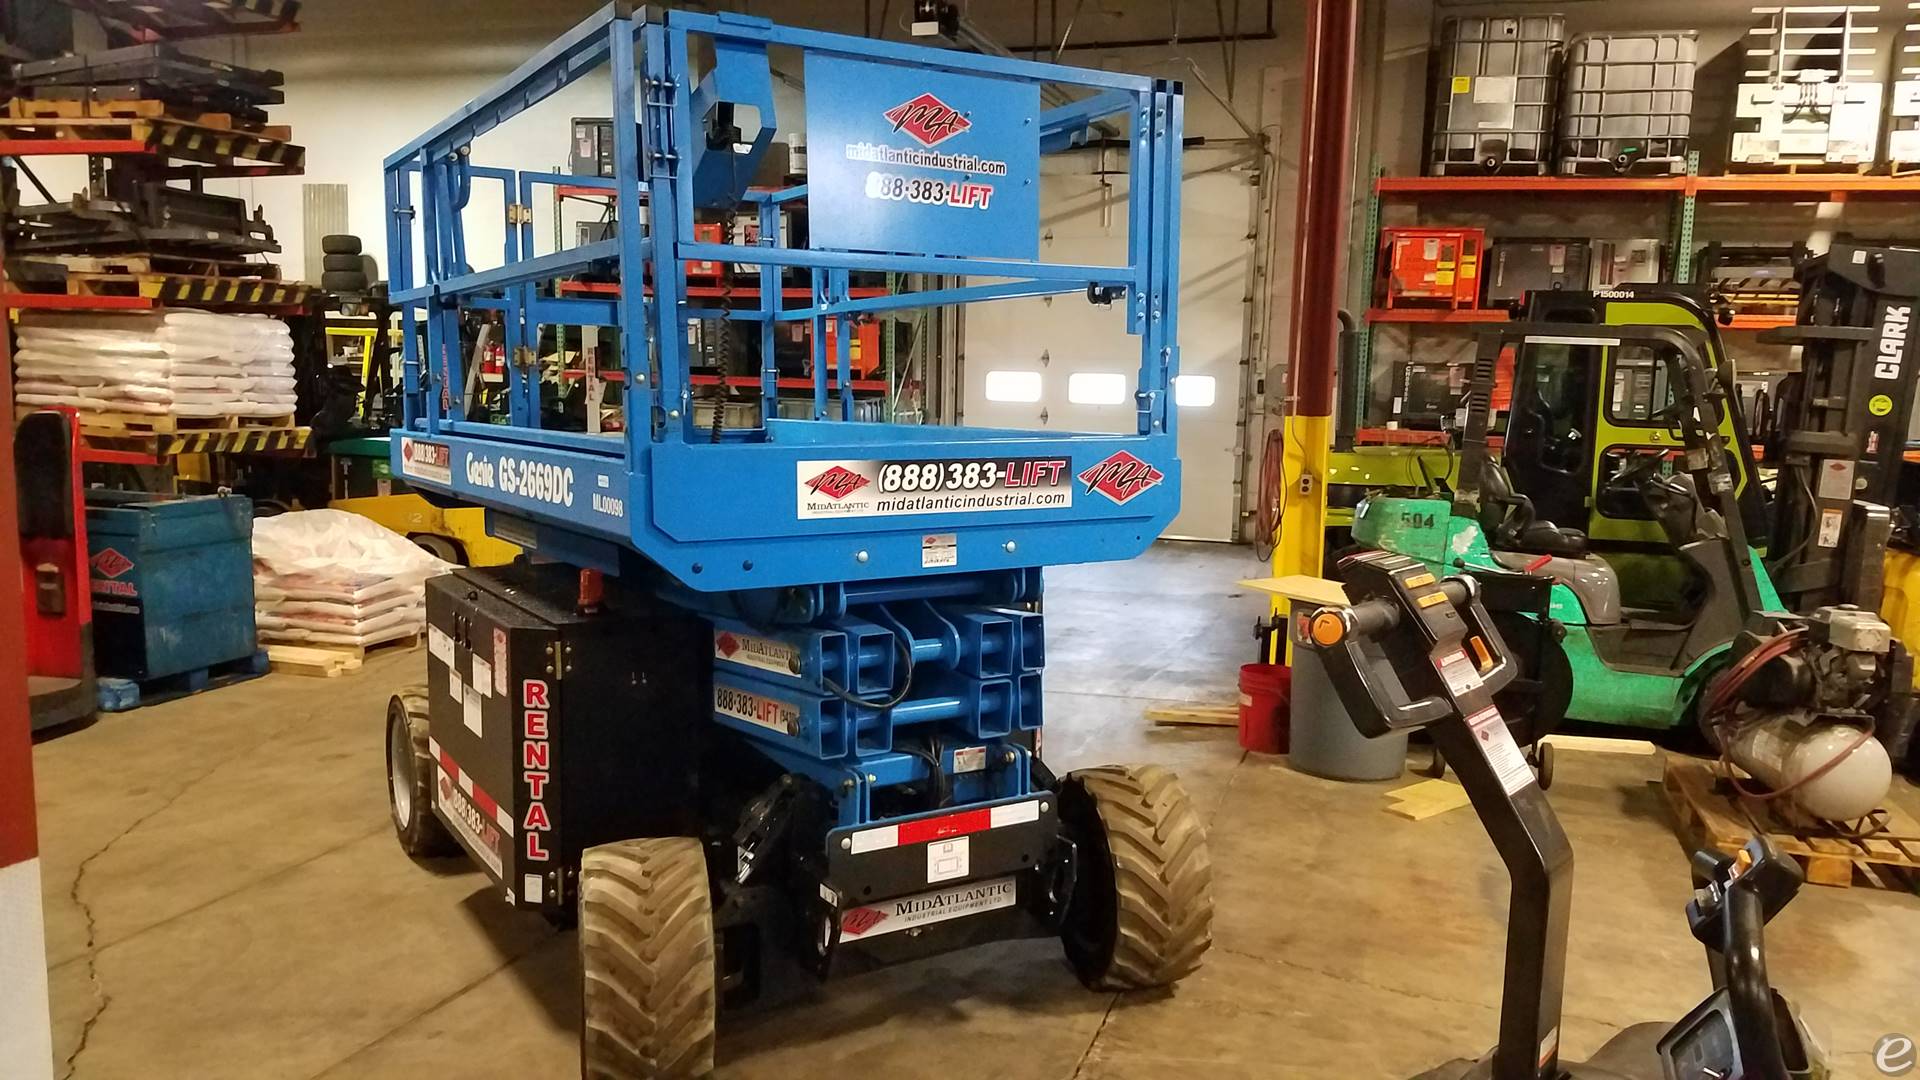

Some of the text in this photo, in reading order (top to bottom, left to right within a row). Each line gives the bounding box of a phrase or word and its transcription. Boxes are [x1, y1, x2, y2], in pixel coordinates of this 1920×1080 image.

[1593, 290, 1634, 298] P1500014
[1874, 305, 1911, 379] CLARK
[587, 347, 595, 401] RENTAL
[466, 452, 574, 507] Genie GS-2669DC
[877, 492, 1065, 512] midatlanticindustrial.com
[1402, 512, 1434, 529] 504
[524, 680, 550, 860] RENTAL
